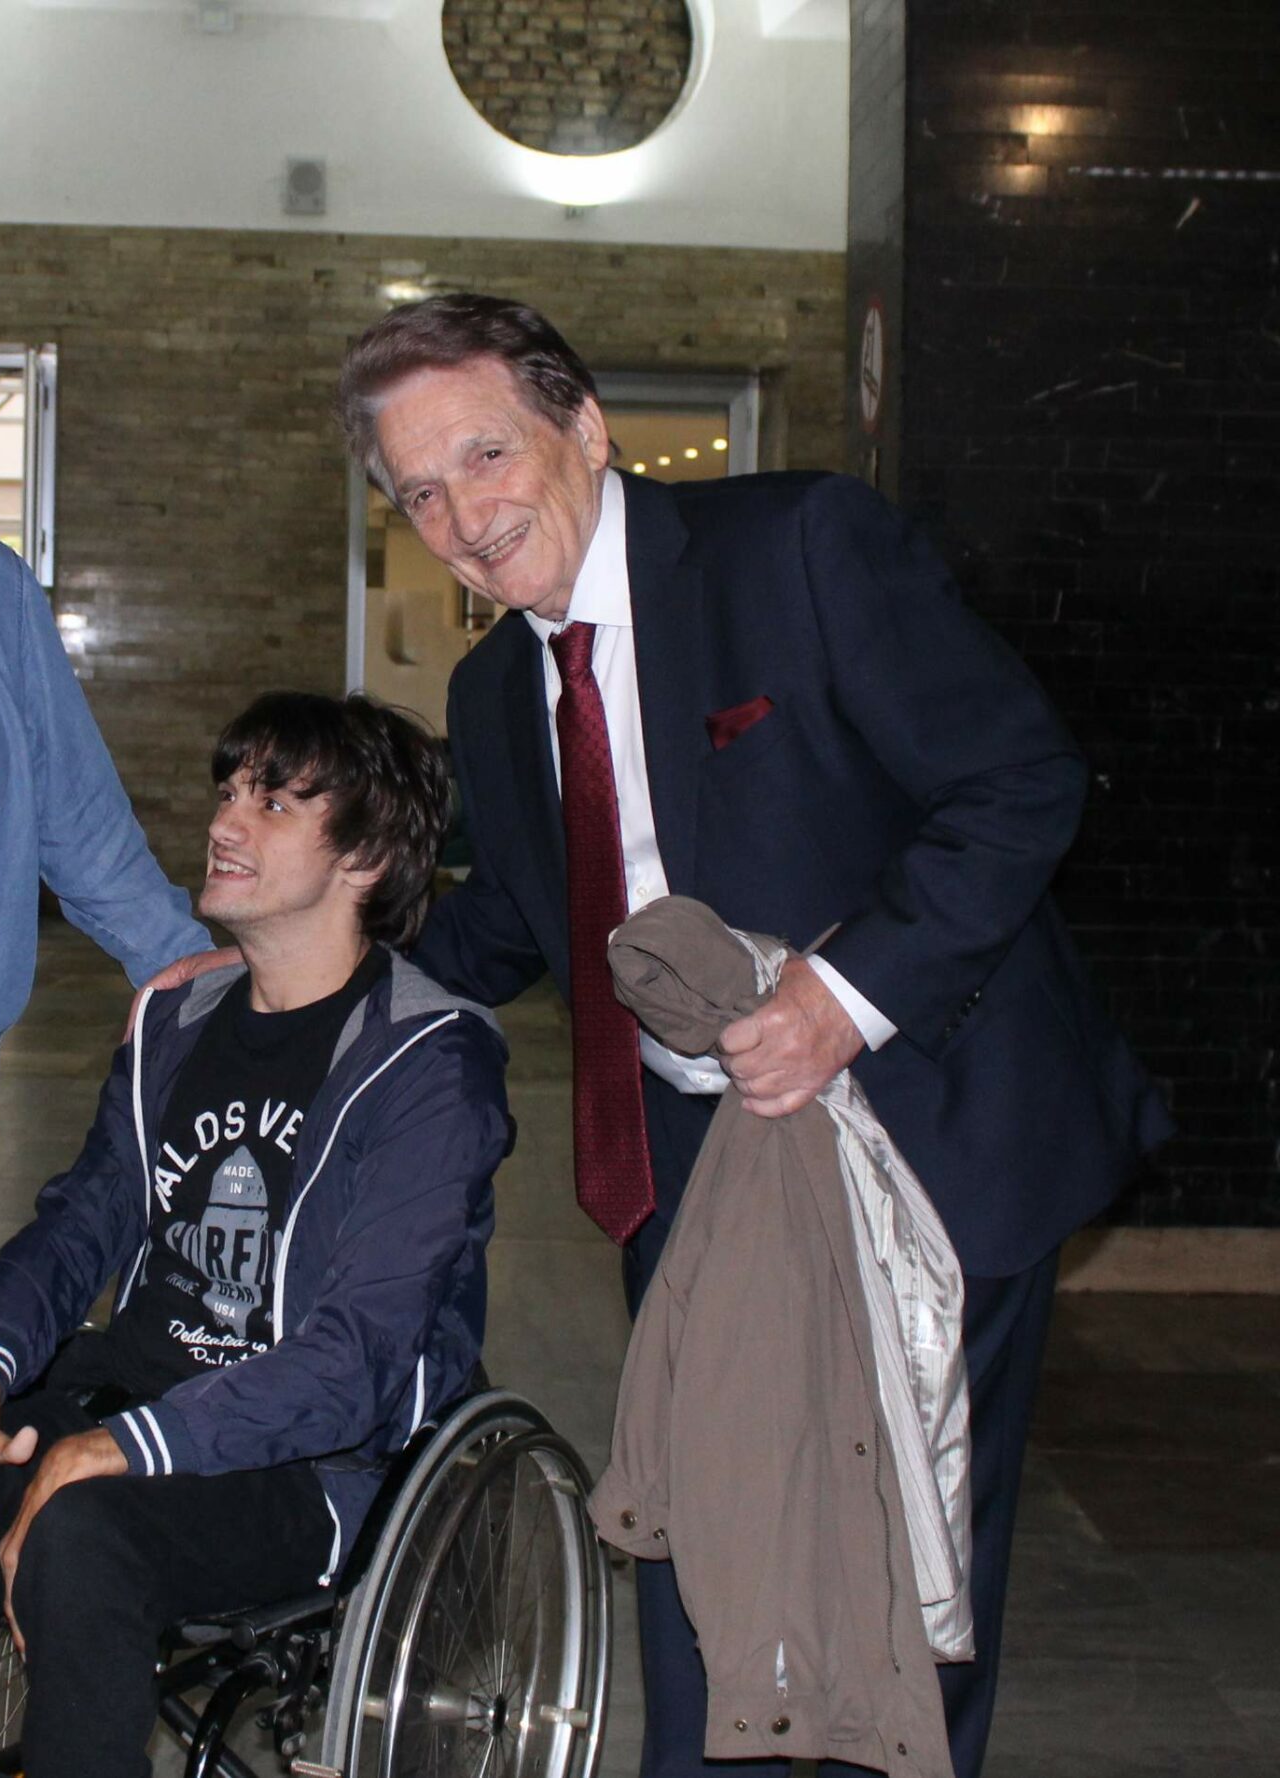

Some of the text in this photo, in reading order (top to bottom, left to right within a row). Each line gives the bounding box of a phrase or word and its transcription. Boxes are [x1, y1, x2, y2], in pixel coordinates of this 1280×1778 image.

[155, 1100, 246, 1213] ALOS
[223, 1166, 255, 1178] MADE
[230, 1183, 243, 1194] IN
[214, 1302, 236, 1318] USA
